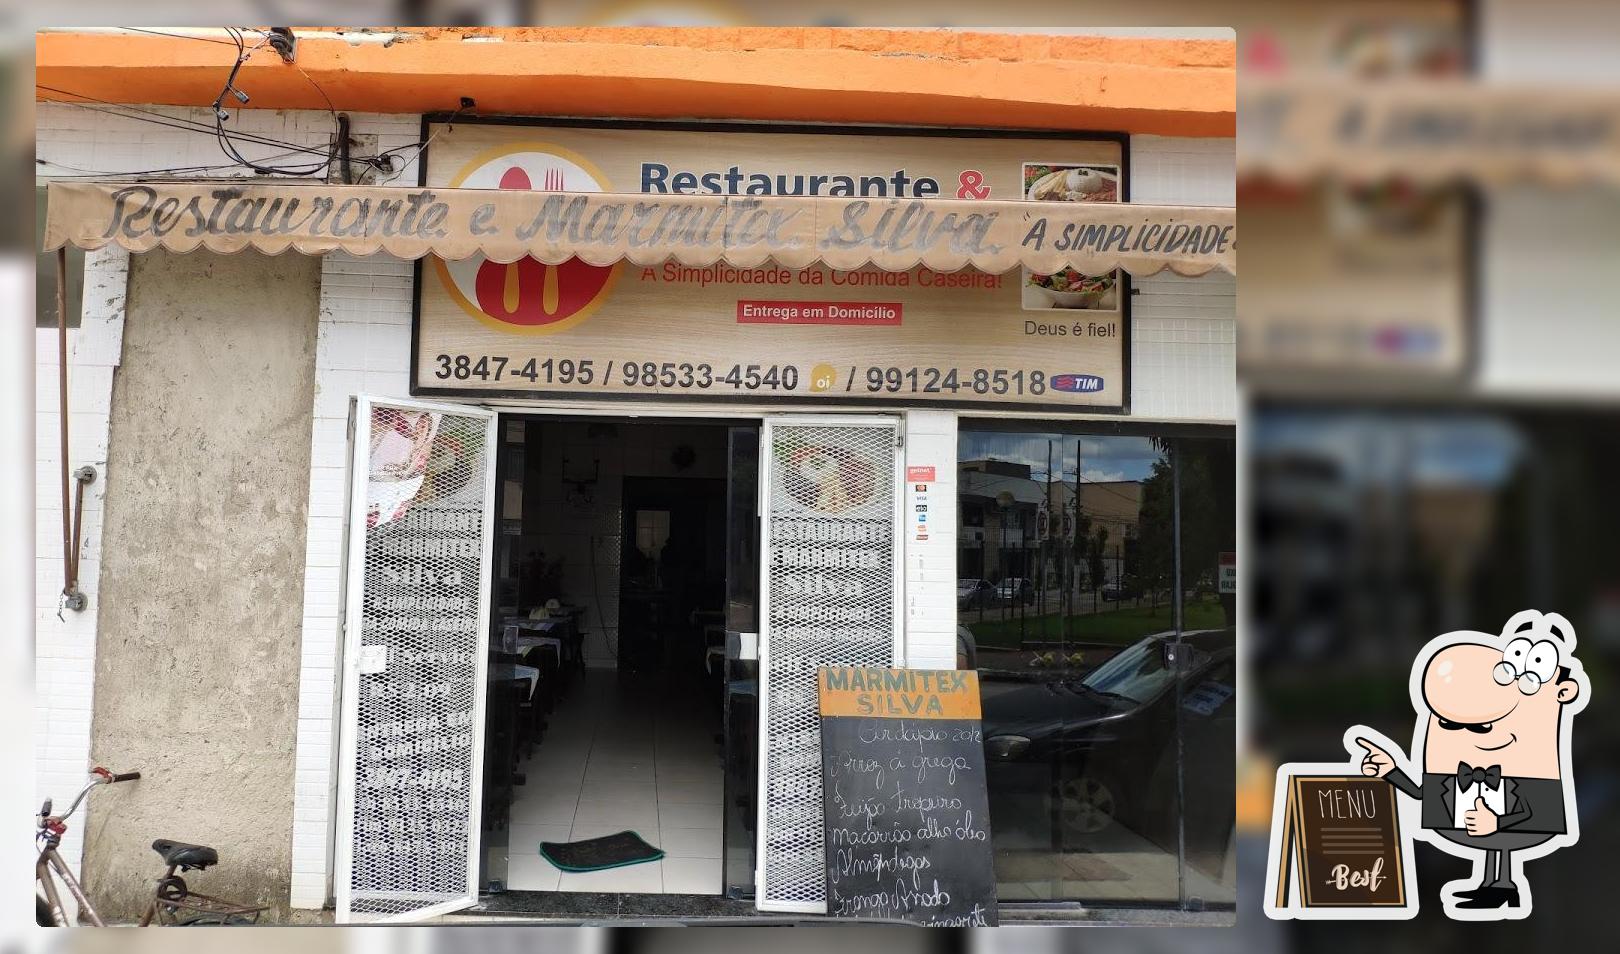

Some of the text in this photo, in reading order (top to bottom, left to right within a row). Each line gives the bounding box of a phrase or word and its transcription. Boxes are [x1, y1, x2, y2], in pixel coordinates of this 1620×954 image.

[639, 161, 992, 201] Restaurante &
[101, 185, 450, 240] Restaurante
[469, 202, 499, 236] e
[1054, 217, 1235, 255] SIMPLICIDADE
[641, 267, 658, 282] A
[662, 262, 792, 288] Simplicidade
[798, 267, 824, 286] da
[830, 269, 910, 288] Comida
[742, 303, 897, 320] Entrega em Domicílio
[1023, 320, 1116, 338] Deus é fiel!
[434, 353, 595, 385] 3847-4195
[622, 362, 800, 391] 98533-4540
[866, 367, 1046, 396] 99124-8518
[1074, 376, 1100, 391] TIM
[825, 667, 968, 693] MARMITEX
[856, 694, 944, 716] SILVA
